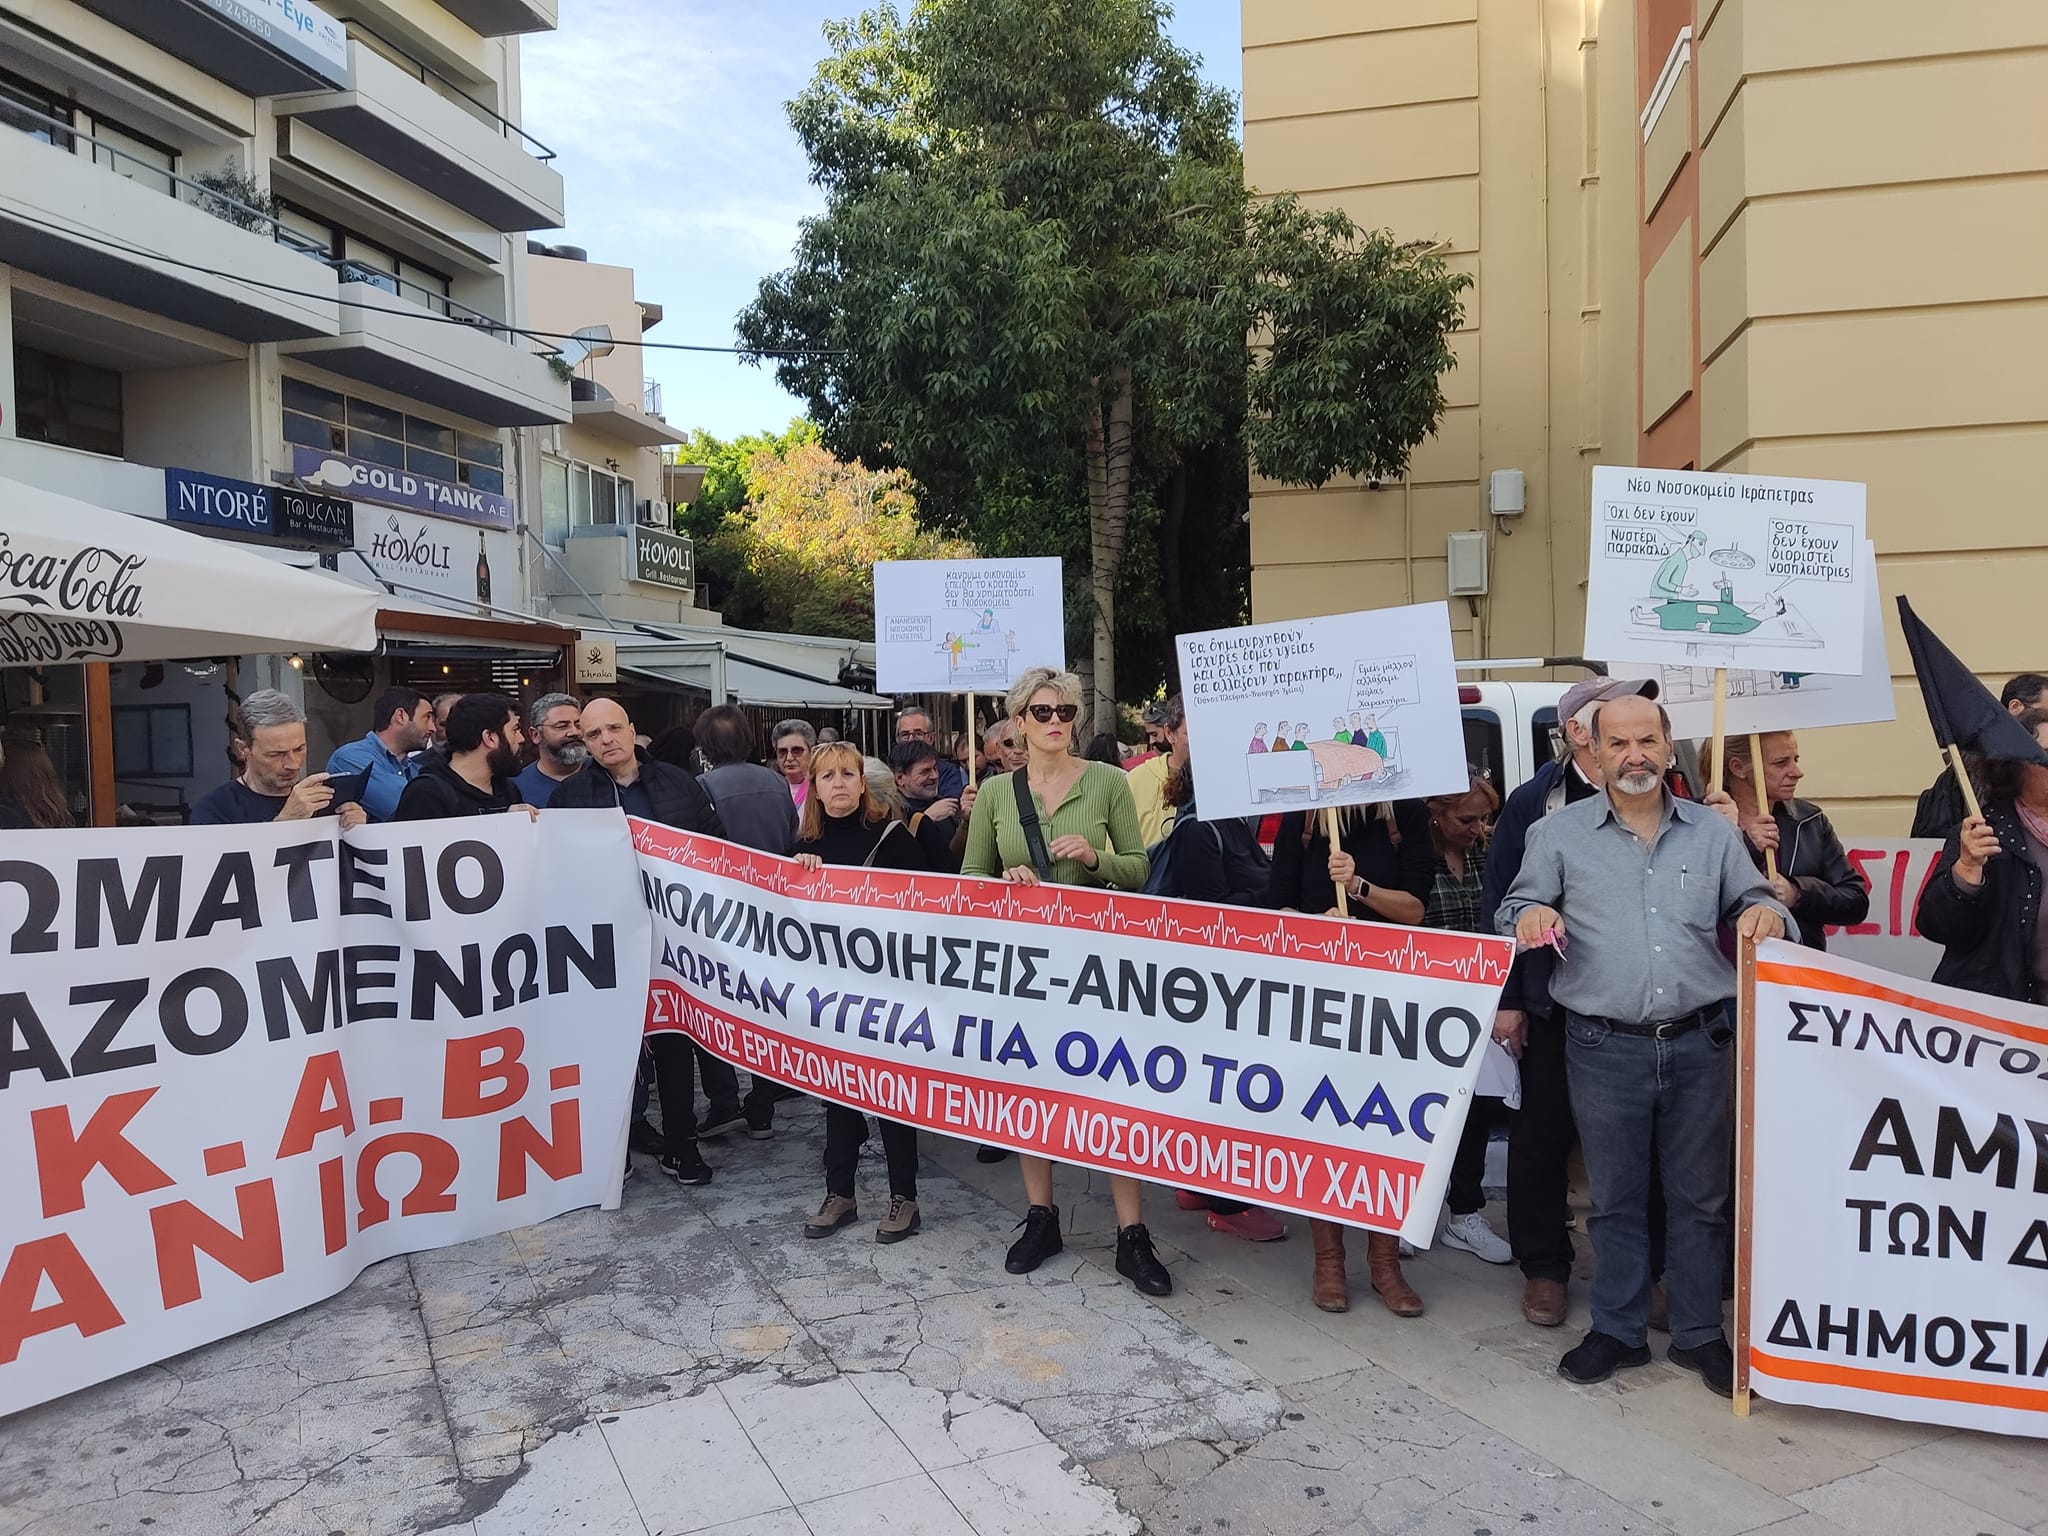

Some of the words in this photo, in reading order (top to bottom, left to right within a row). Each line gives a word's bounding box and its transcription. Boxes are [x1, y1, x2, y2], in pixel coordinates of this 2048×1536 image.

[352, 465, 417, 496] GOLD
[424, 481, 484, 512] TANK
[1627, 477, 1651, 493] Νέο
[1656, 481, 1735, 500] Νοσοκομείο
[1741, 484, 1814, 505] Ιεράπετρας
[178, 480, 268, 526] NTORÉ
[283, 496, 346, 525] TOUCAN
[1634, 506, 1655, 520] δεν
[1660, 506, 1695, 523] έχουν
[290, 519, 302, 528] Bar
[1611, 528, 1657, 544] Νυστέρι
[372, 532, 450, 569] HOVOLI
[640, 538, 691, 571] HOVOLI
[1607, 542, 1670, 557] παρακαλώ
[1772, 535, 1796, 548] δεν
[1801, 537, 1839, 551] έχουν
[1772, 548, 1834, 564] διοριστεί
[1210, 629, 1304, 652] δημιουργηθούν
[1193, 668, 1213, 681] και
[1193, 682, 1208, 694] θα
[661, 936, 795, 1020] ΔΩΡΕΑΝ
[806, 986, 935, 1053] ΥΓΕΙΑ
[952, 1014, 1037, 1069] ΓΙΑ
[1055, 1030, 1187, 1094] ΟΛΟ
[1202, 1053, 1285, 1113] ΤΟ
[651, 988, 740, 1058] ΣΥΛΛΟΓΟΣ
[742, 1028, 917, 1117] ΕΡΓΑΖΟΜΕΝΩΝ
[926, 1081, 1059, 1144] ΓΕΝΙΚΟΥ
[1063, 1106, 1313, 1199] ΝΟΣΟΚΟΜΕΙΟΥ
[1845, 1198, 1987, 1262] ΤΩΝ
